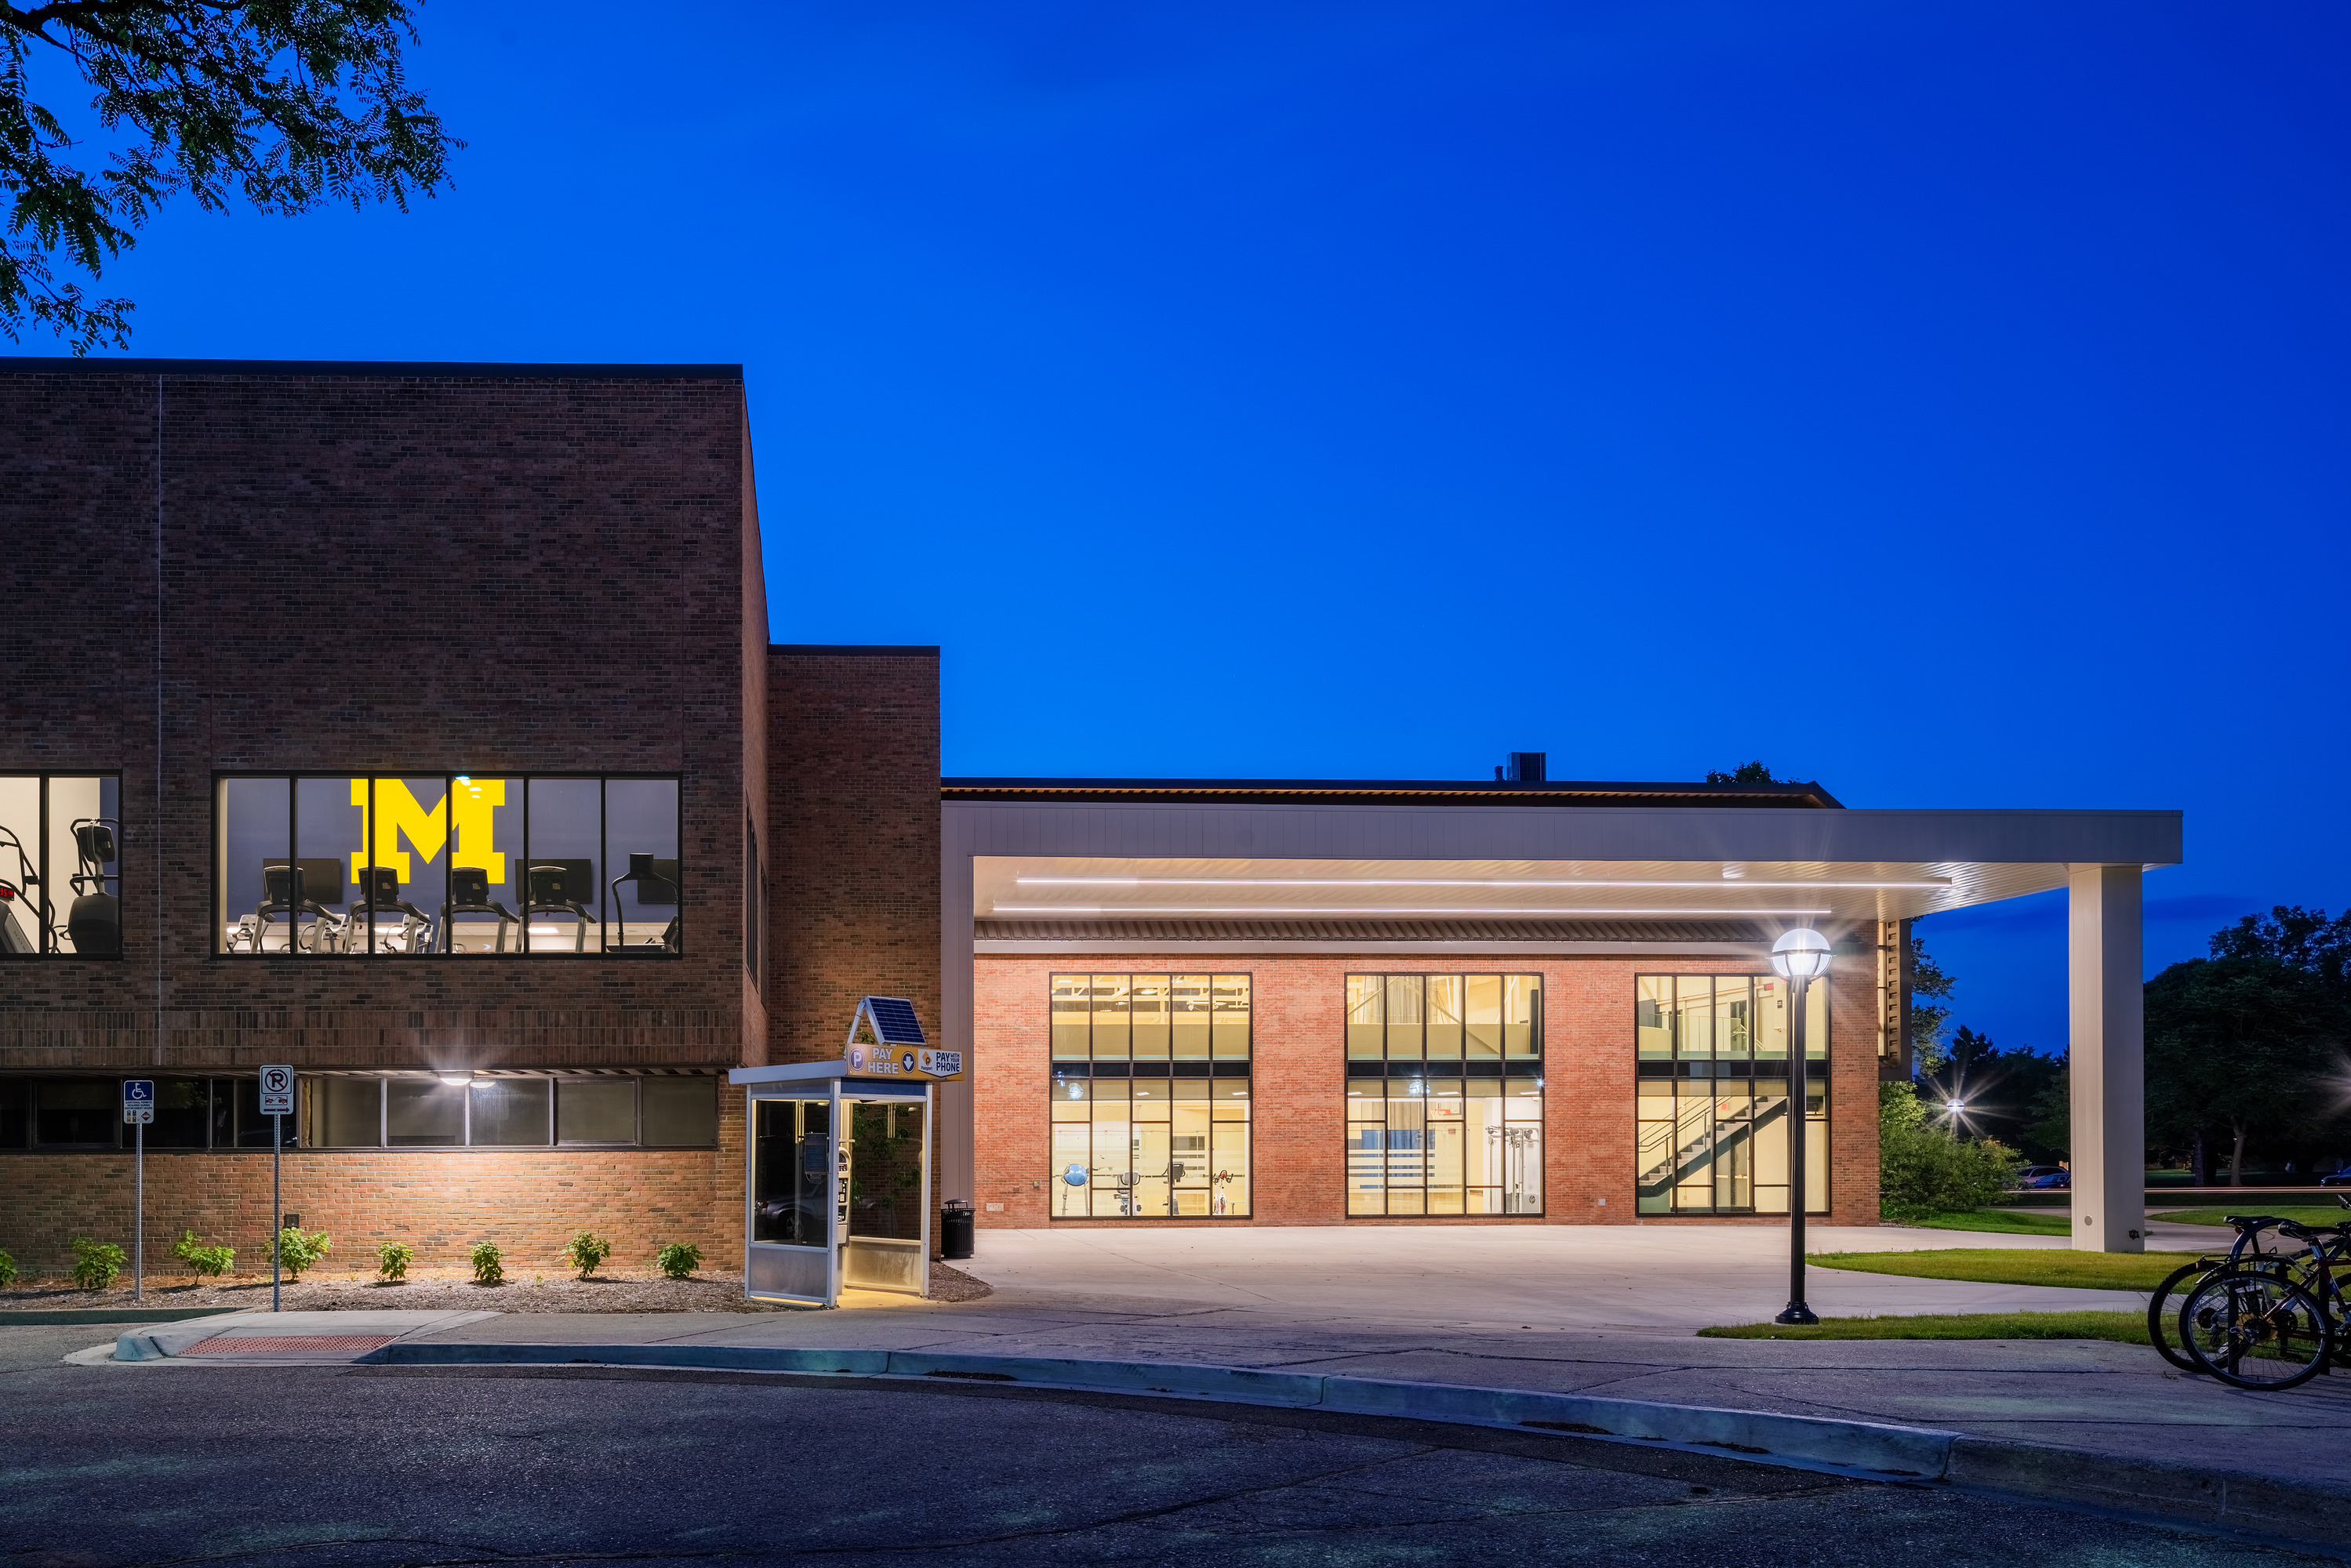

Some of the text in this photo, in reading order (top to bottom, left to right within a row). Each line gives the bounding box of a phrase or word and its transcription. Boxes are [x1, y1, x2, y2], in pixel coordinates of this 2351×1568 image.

[351, 779, 505, 884] M
[854, 1050, 863, 1067] P
[873, 1048, 892, 1060] PAY
[936, 1052, 950, 1062] PAY
[867, 1061, 899, 1074] HERE
[936, 1062, 960, 1072] PHONE
[271, 1073, 284, 1088] P
